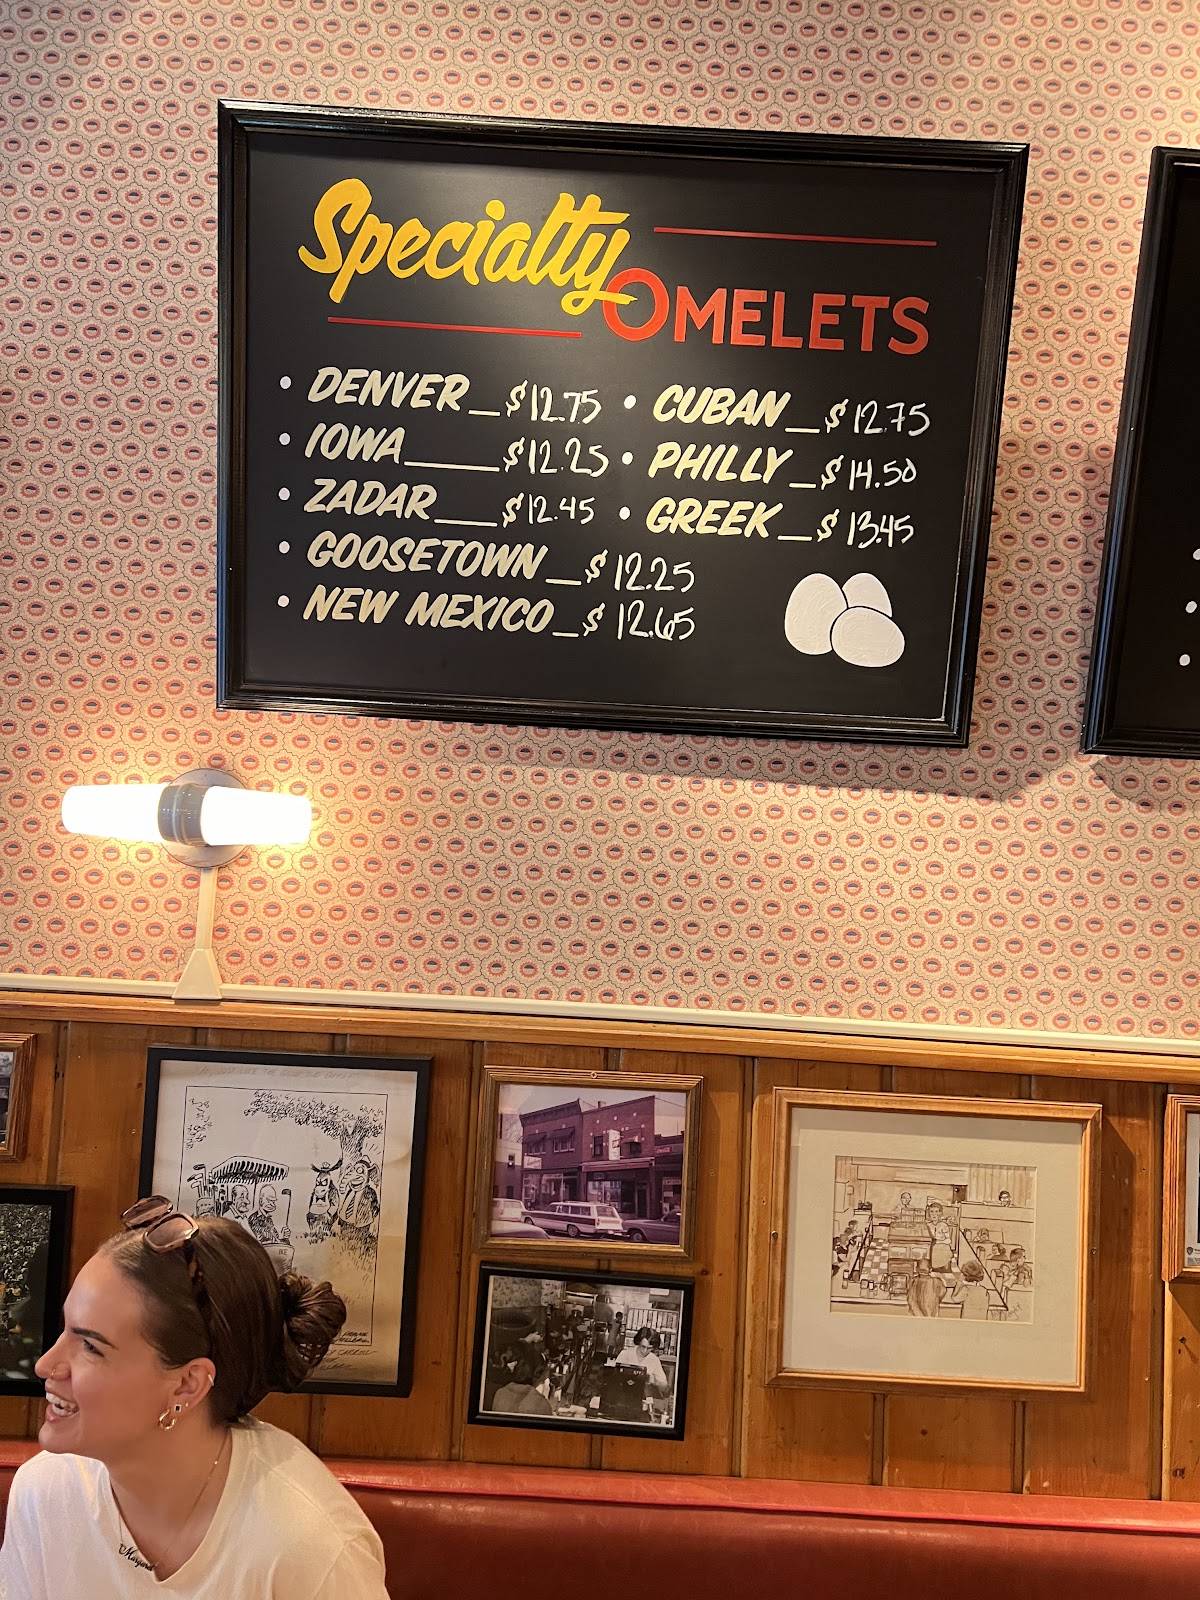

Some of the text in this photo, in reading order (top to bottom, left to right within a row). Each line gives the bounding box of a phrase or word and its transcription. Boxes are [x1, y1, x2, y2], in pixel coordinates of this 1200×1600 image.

[298, 178, 638, 316] Specialty
[603, 267, 930, 355] OMELETS
[307, 366, 471, 412] DENVER
[653, 384, 792, 429] CUBAN
[304, 422, 407, 464] IOWA
[647, 441, 794, 484] PHILLY
[303, 478, 438, 520] ZADAR
[645, 496, 784, 539] GREEK
[306, 530, 549, 580] GOOSETOWN
[303, 584, 400, 625] NEW
[404, 591, 555, 633] MEXICO
